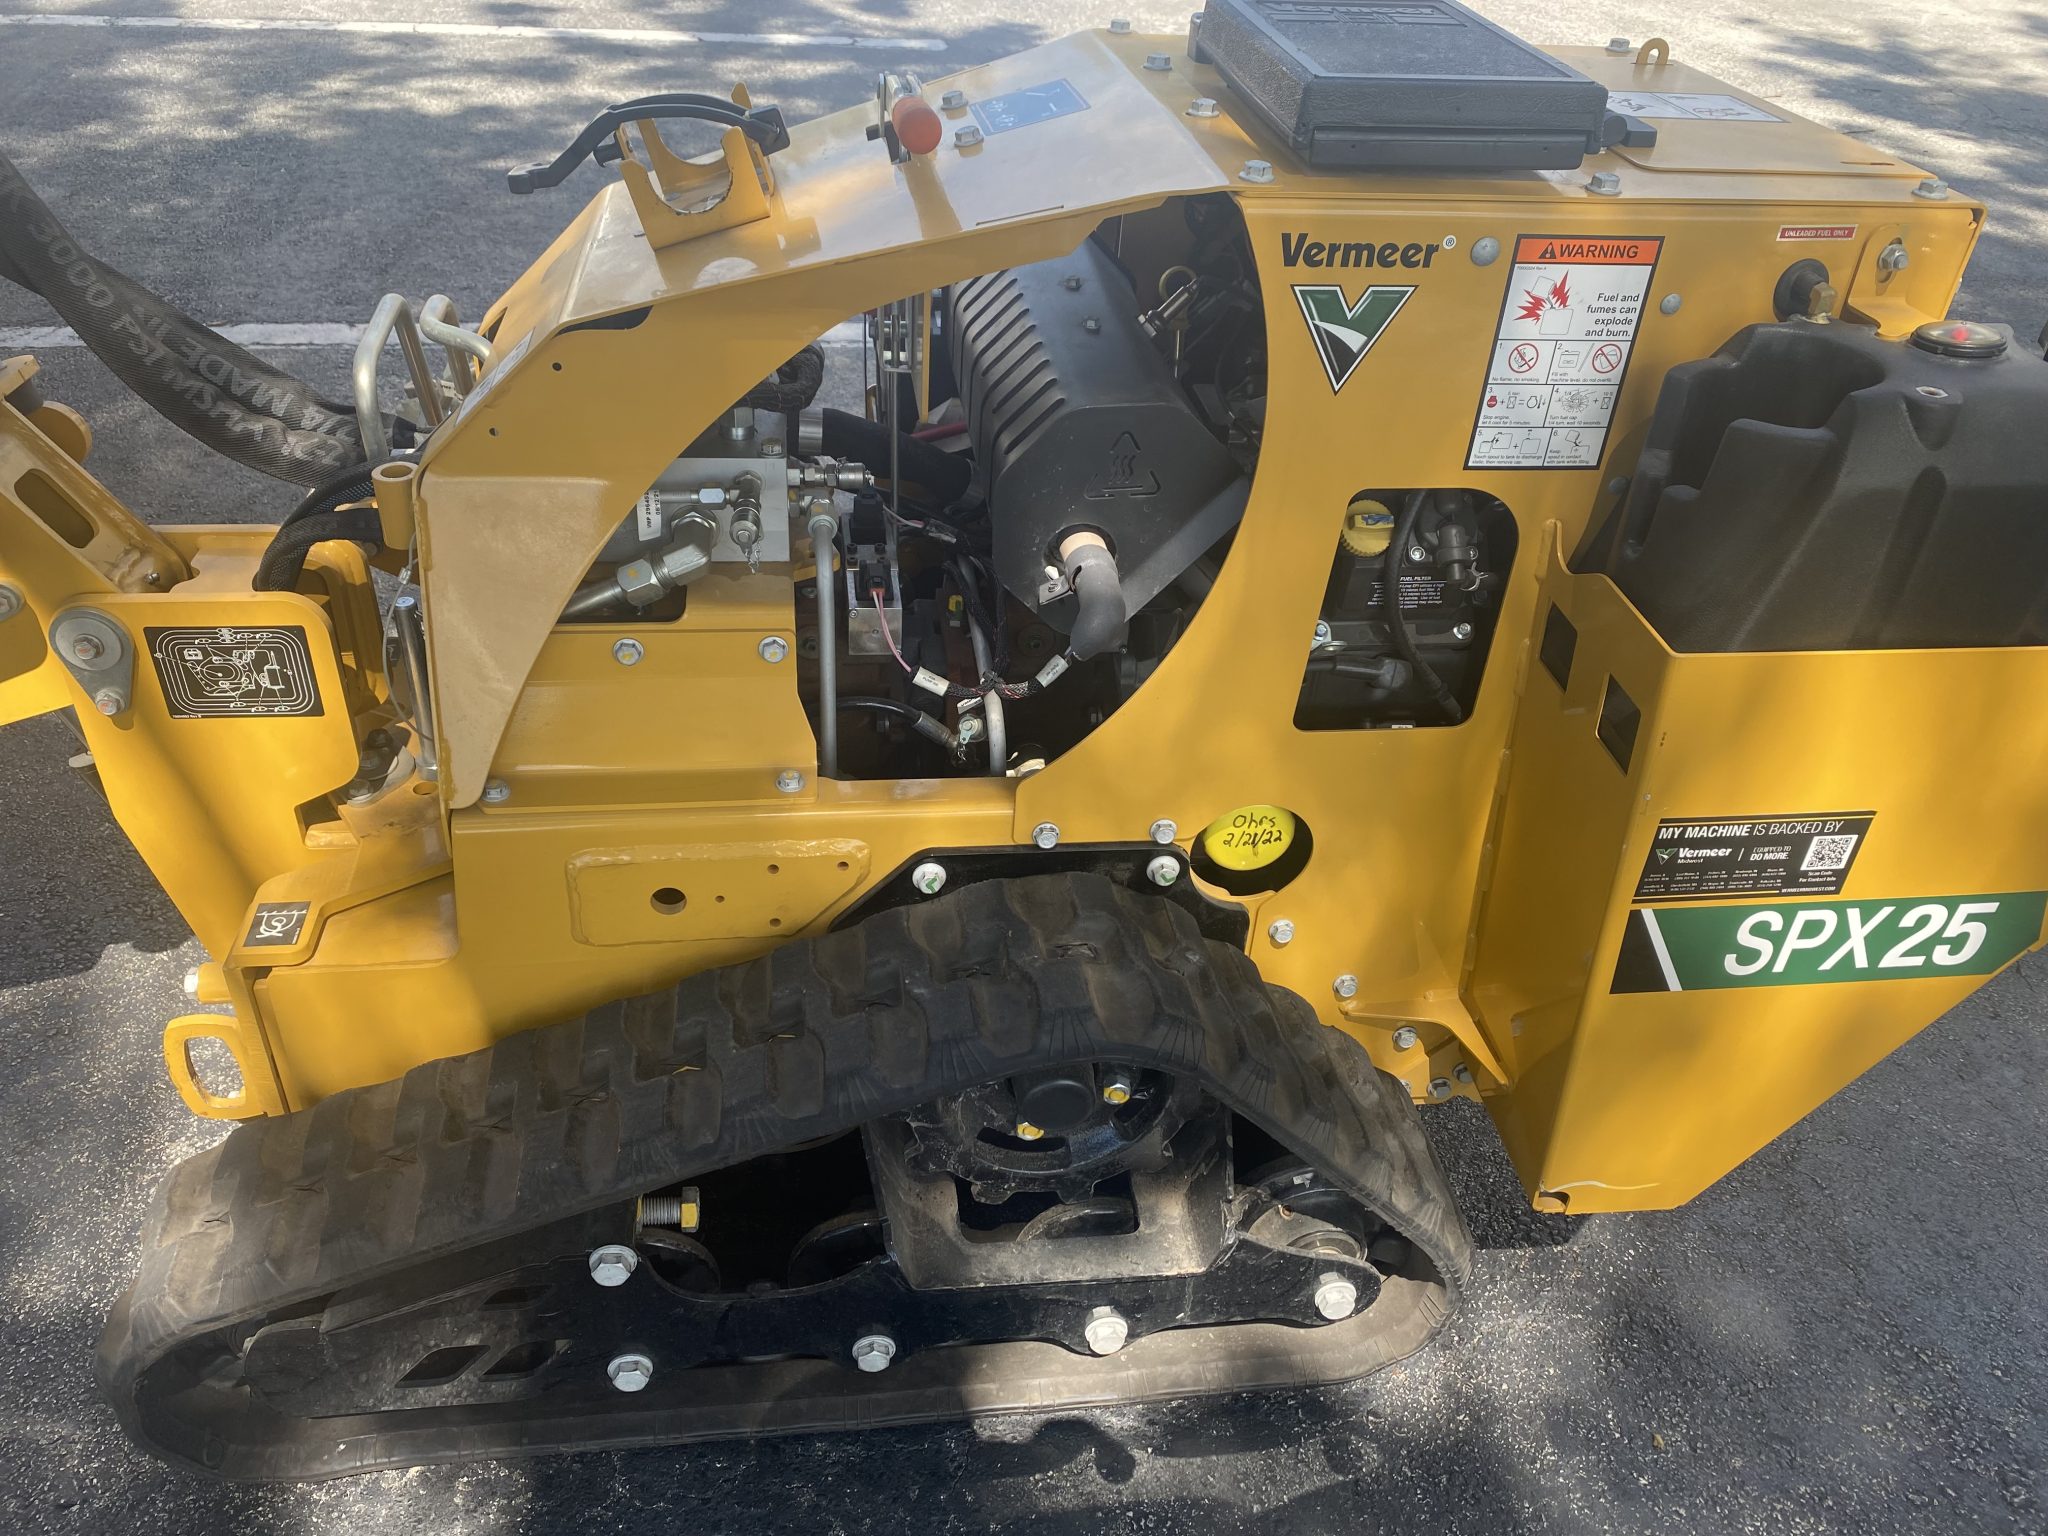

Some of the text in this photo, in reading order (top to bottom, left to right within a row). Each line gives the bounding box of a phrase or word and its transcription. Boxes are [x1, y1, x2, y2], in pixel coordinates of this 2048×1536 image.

[1785, 229, 1849, 238] UNLEADED FUEL ONLY
[1281, 233, 1440, 268] Vermeer
[1559, 244, 1639, 258] WARNING
[1597, 293, 1640, 302] Fuel and
[1586, 305, 1616, 314] fumes
[1594, 317, 1633, 327] explode
[1585, 328, 1631, 337] and burn.
[180, 337, 294, 417] MADE
[1658, 821, 1844, 839] MY MACHINE IS BACKED BY
[1678, 847, 1732, 858] Vermeer
[1763, 852, 1789, 860] MORE.
